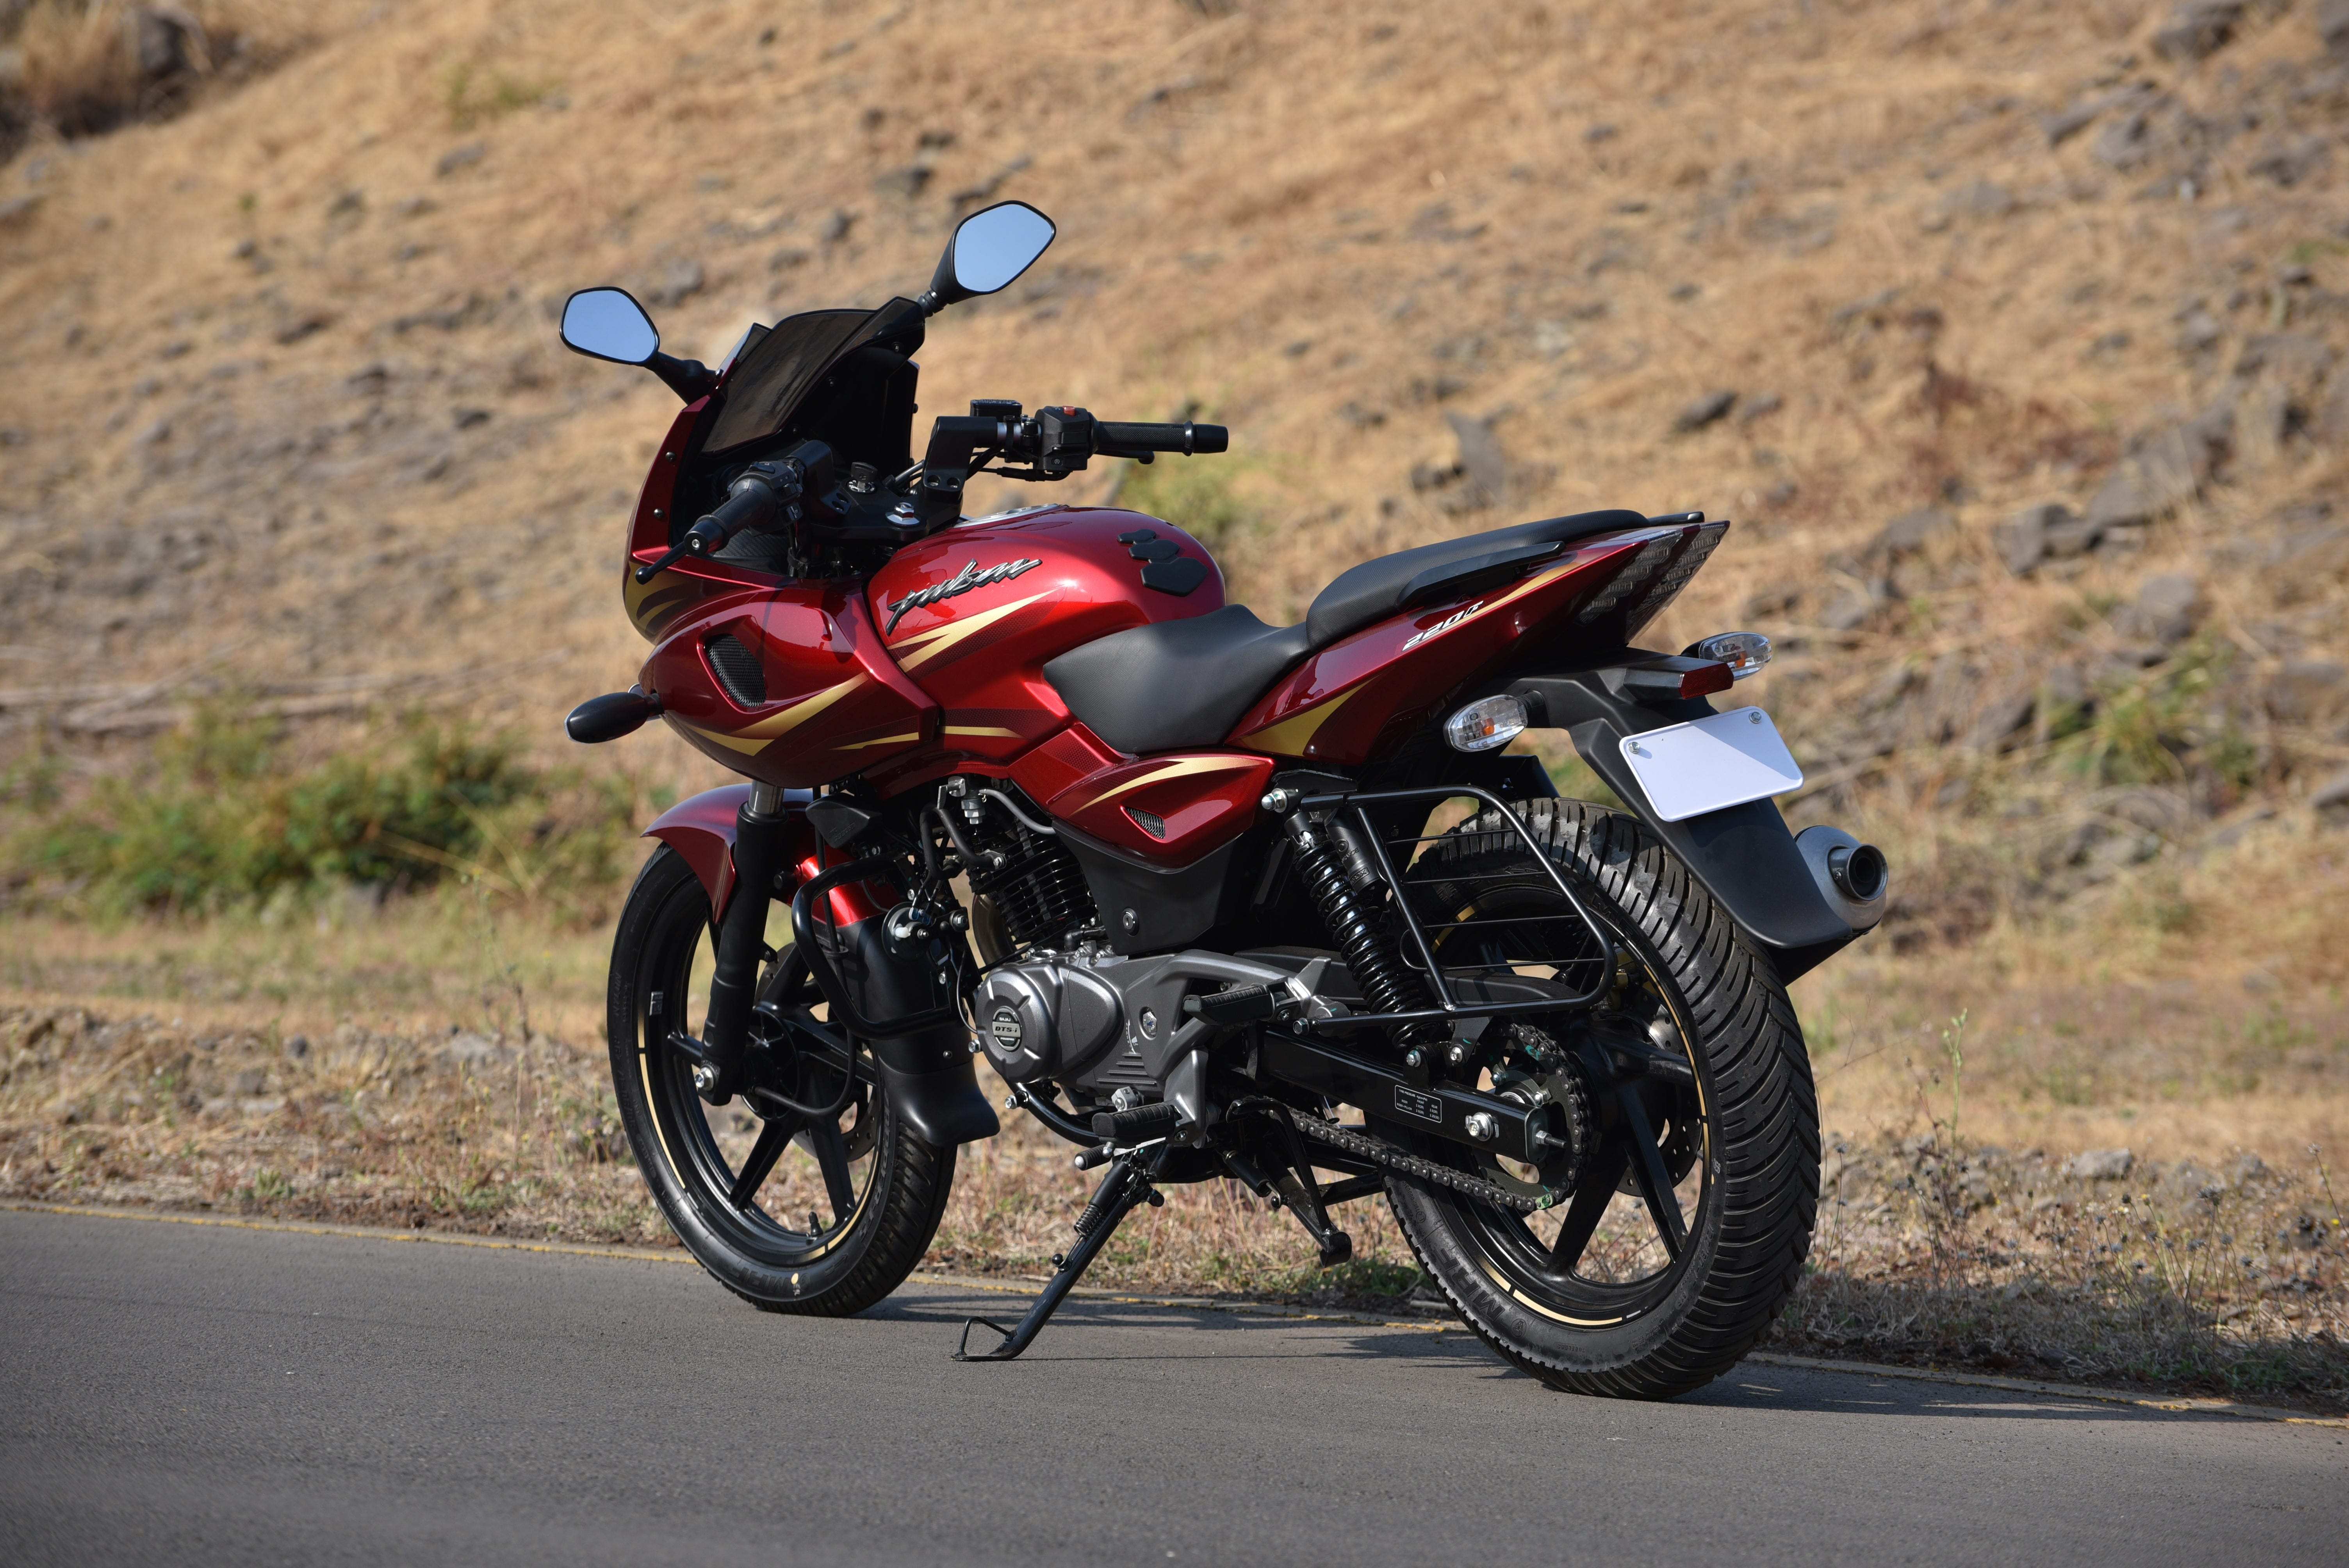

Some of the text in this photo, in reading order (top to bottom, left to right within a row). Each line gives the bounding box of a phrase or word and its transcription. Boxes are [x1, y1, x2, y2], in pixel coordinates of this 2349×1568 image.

[1401, 600, 1484, 652] 220F
[727, 1267, 791, 1295] MRF
[1433, 1248, 1506, 1322] MRF
[1556, 1343, 1586, 1354] TUBELESS
